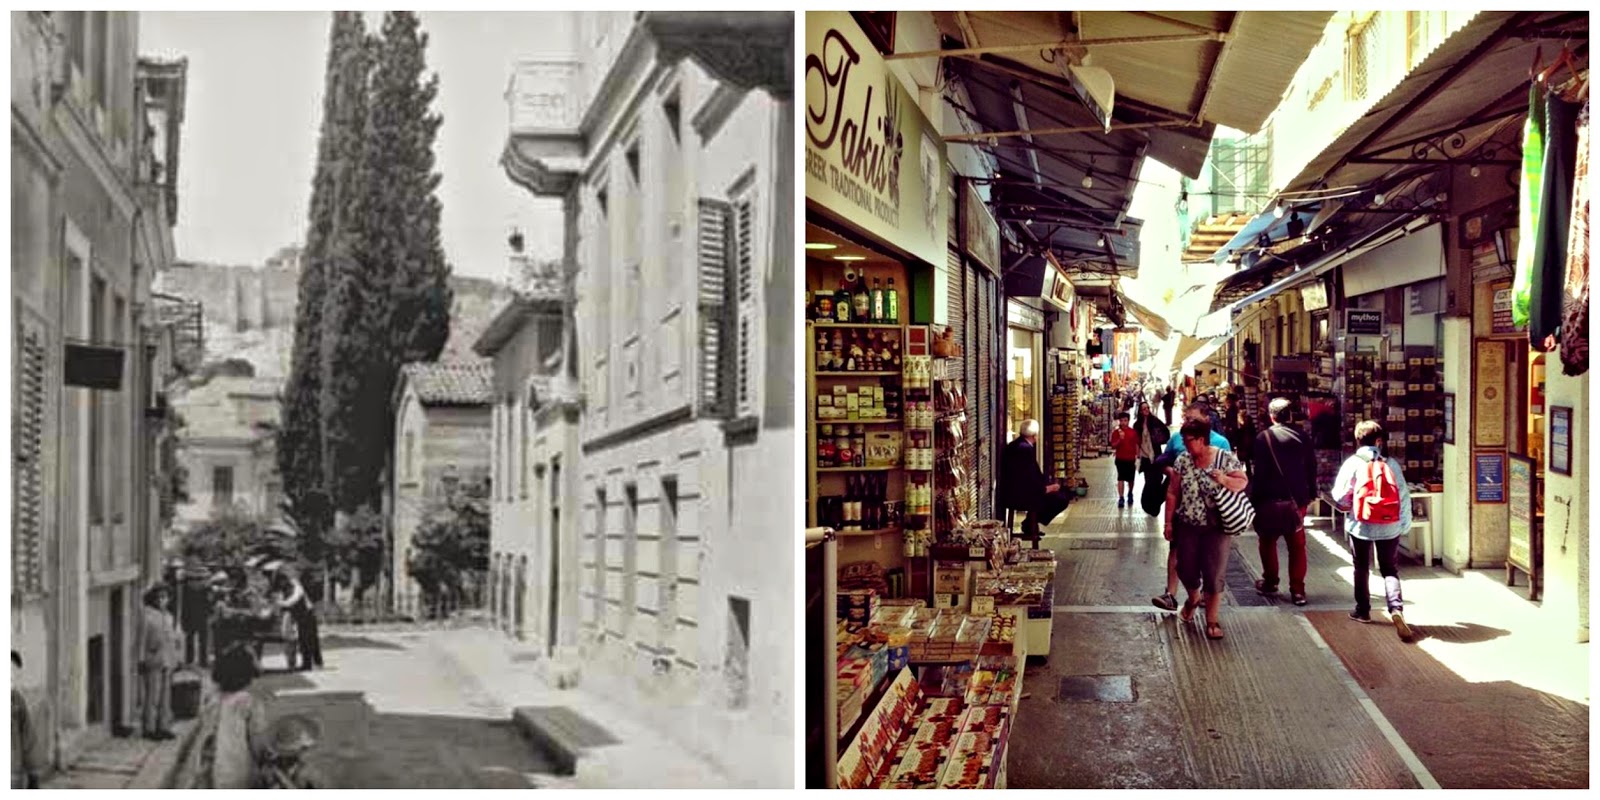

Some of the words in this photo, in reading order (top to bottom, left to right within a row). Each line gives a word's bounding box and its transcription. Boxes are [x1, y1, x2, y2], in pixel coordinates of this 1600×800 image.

[805, 28, 887, 195] Takis
[830, 163, 873, 214] TRADITIONAL
[1351, 313, 1380, 322] mythos
